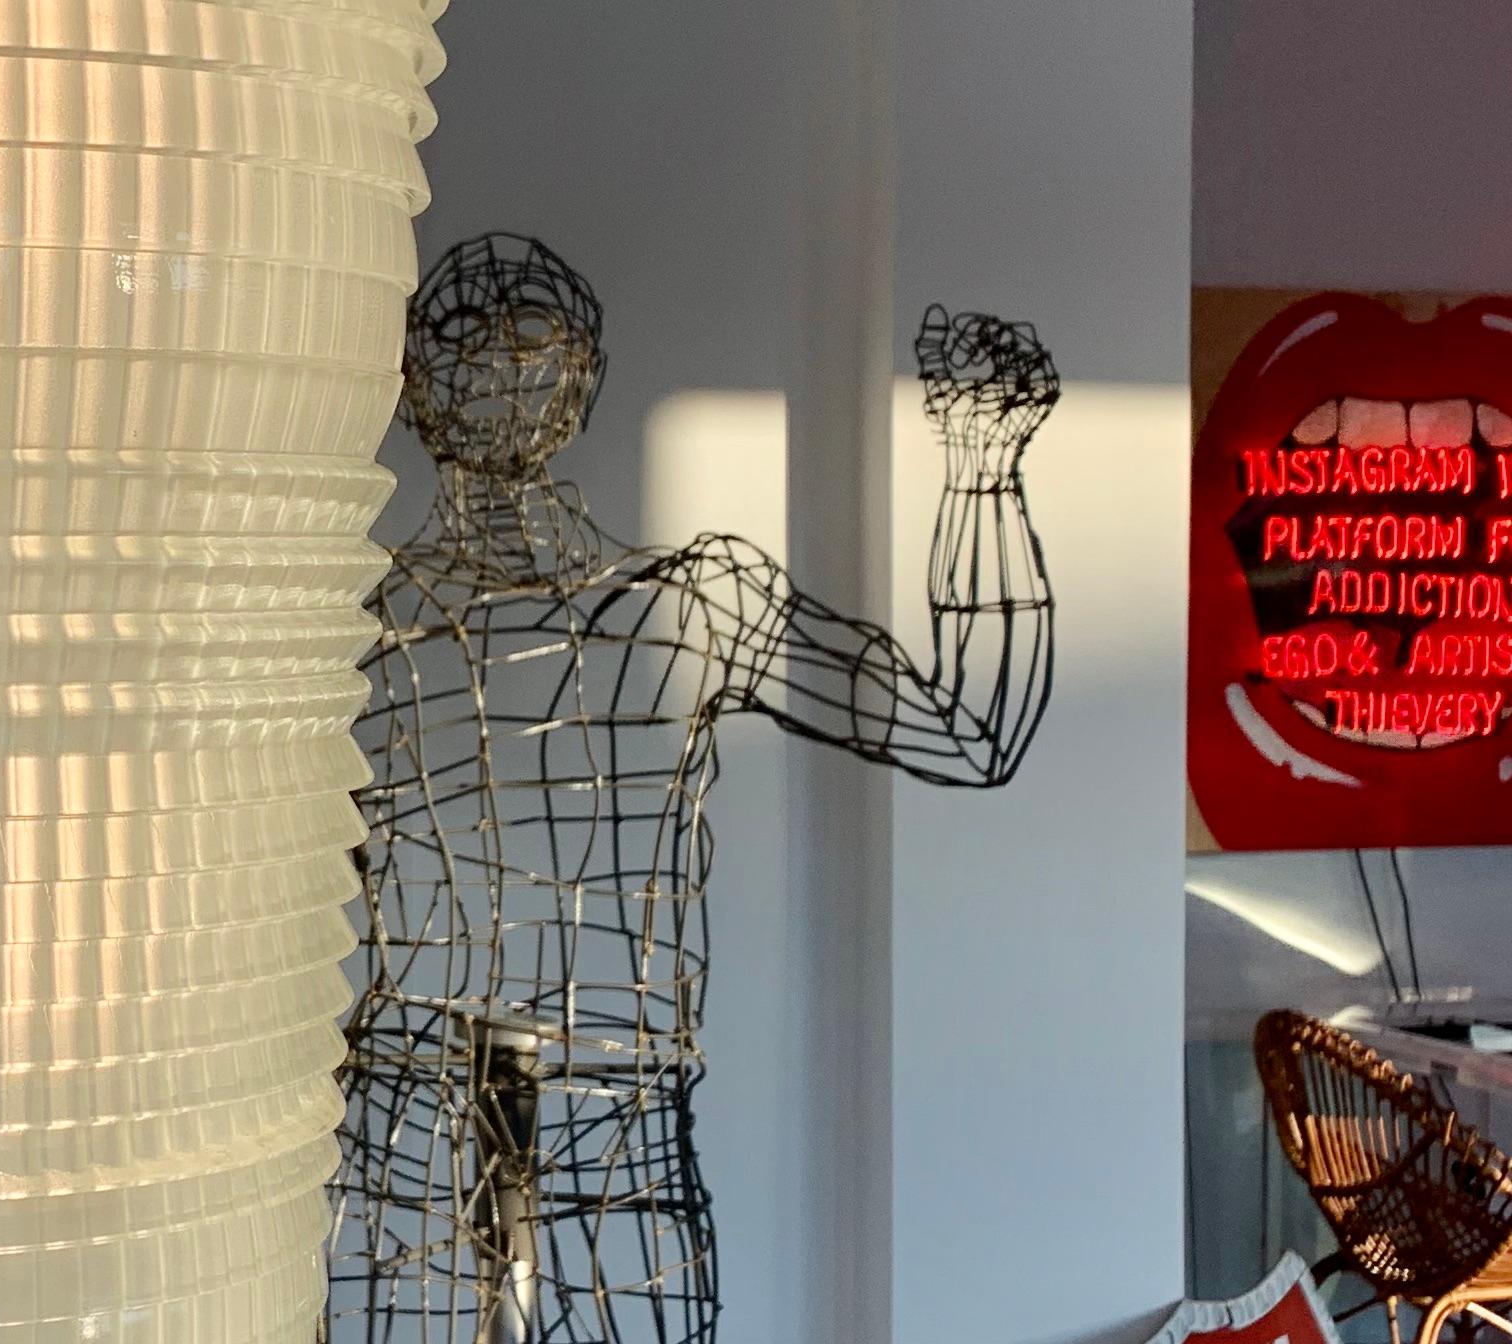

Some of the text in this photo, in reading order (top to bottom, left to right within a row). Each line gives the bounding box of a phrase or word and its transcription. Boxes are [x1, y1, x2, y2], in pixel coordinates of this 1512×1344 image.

[1243, 447, 1473, 497] INSTAGRAM
[1263, 515, 1465, 561] PLATFORM
[1307, 568, 1512, 623] ADDICTION
[1262, 632, 1338, 679] EGO
[1347, 631, 1379, 676] &
[1325, 690, 1502, 736] THIEVERY
